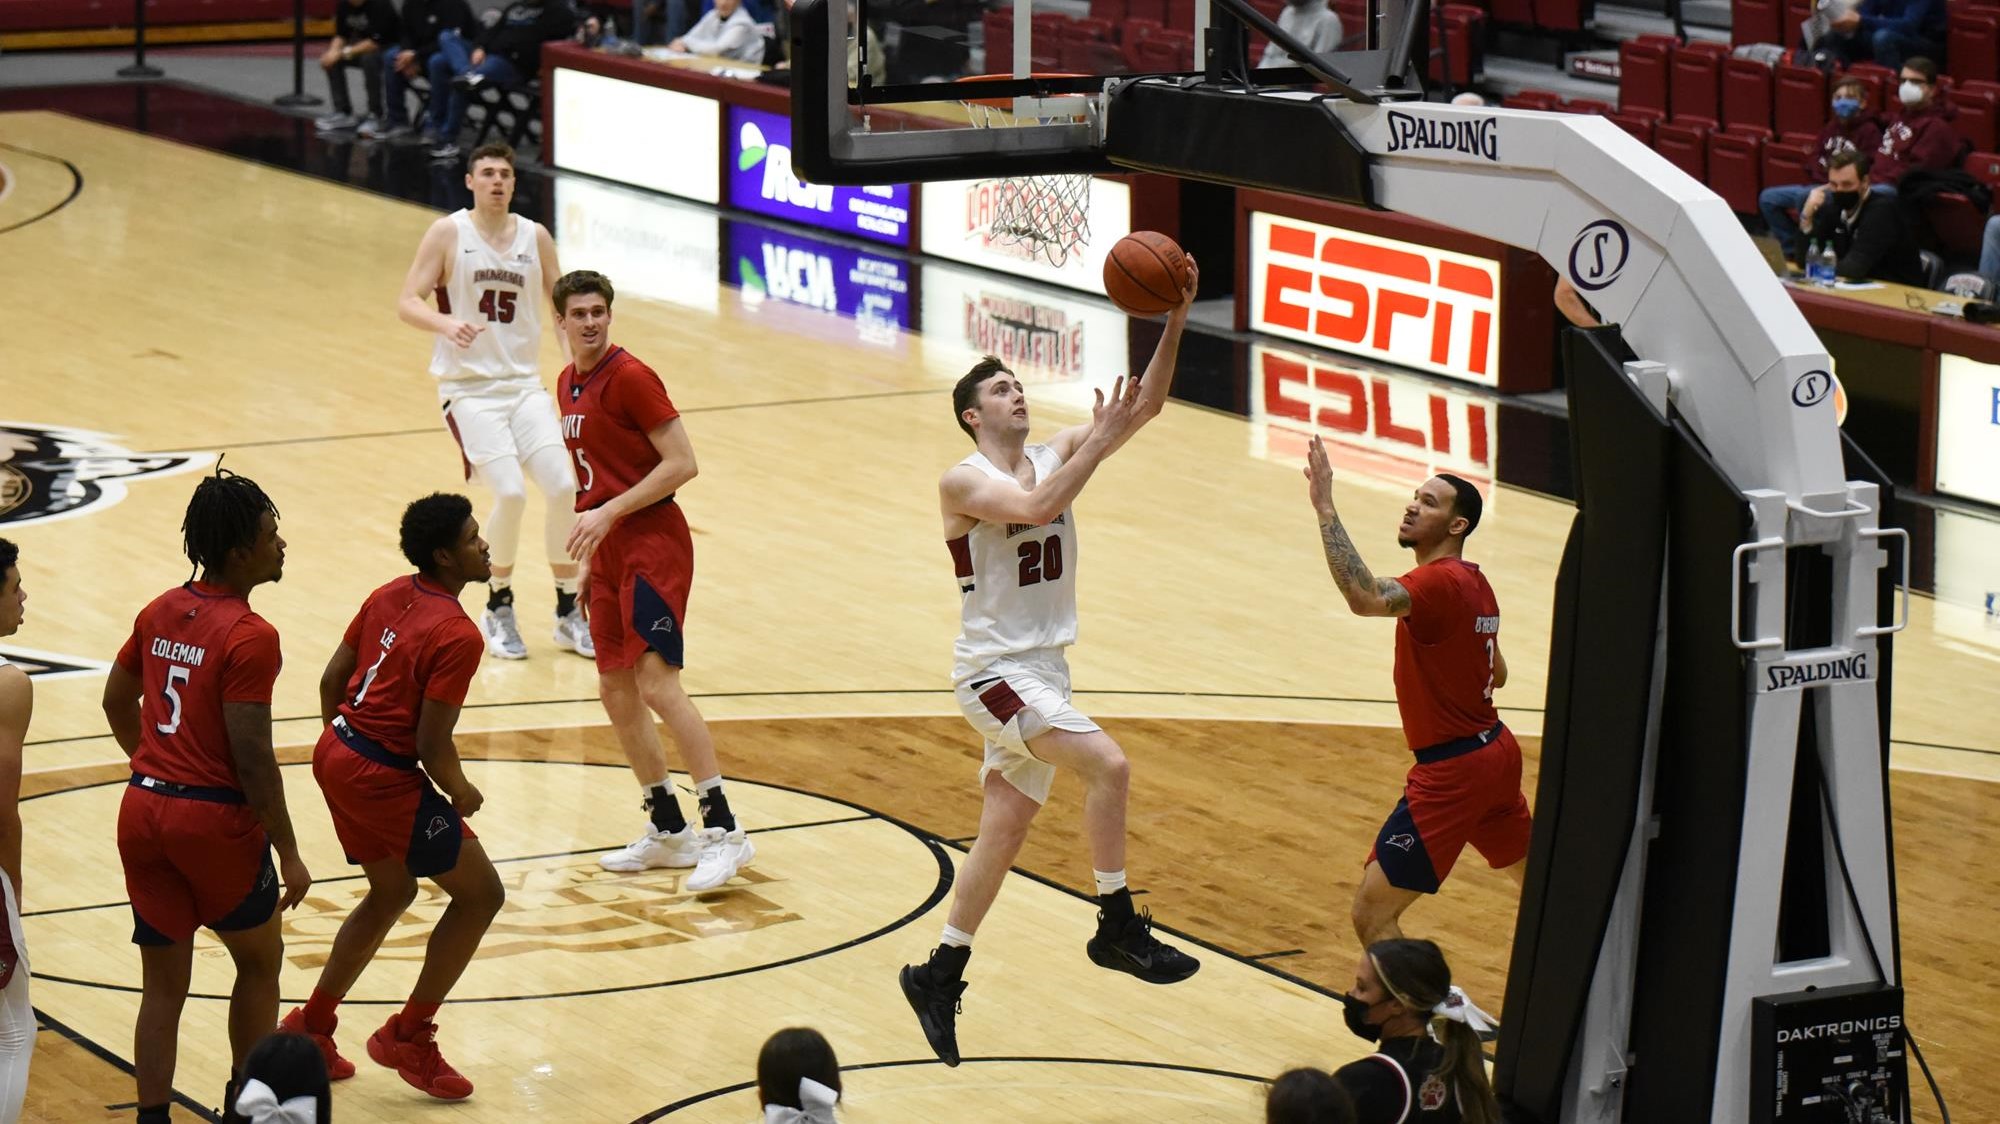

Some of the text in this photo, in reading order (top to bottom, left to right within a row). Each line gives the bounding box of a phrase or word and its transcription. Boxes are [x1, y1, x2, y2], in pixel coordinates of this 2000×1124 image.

[1387, 110, 1497, 162] SPALDING
[478, 289, 518, 325] 45
[1263, 223, 1494, 376] ESPN
[1017, 534, 1063, 587] 20
[151, 637, 206, 667] COLEMAN
[380, 627, 396, 650] LEE
[353, 650, 387, 707] 1
[1767, 653, 1866, 692] SPALDING
[157, 665, 190, 734] 5
[1776, 1016, 1901, 1043] DAKTRONICS
